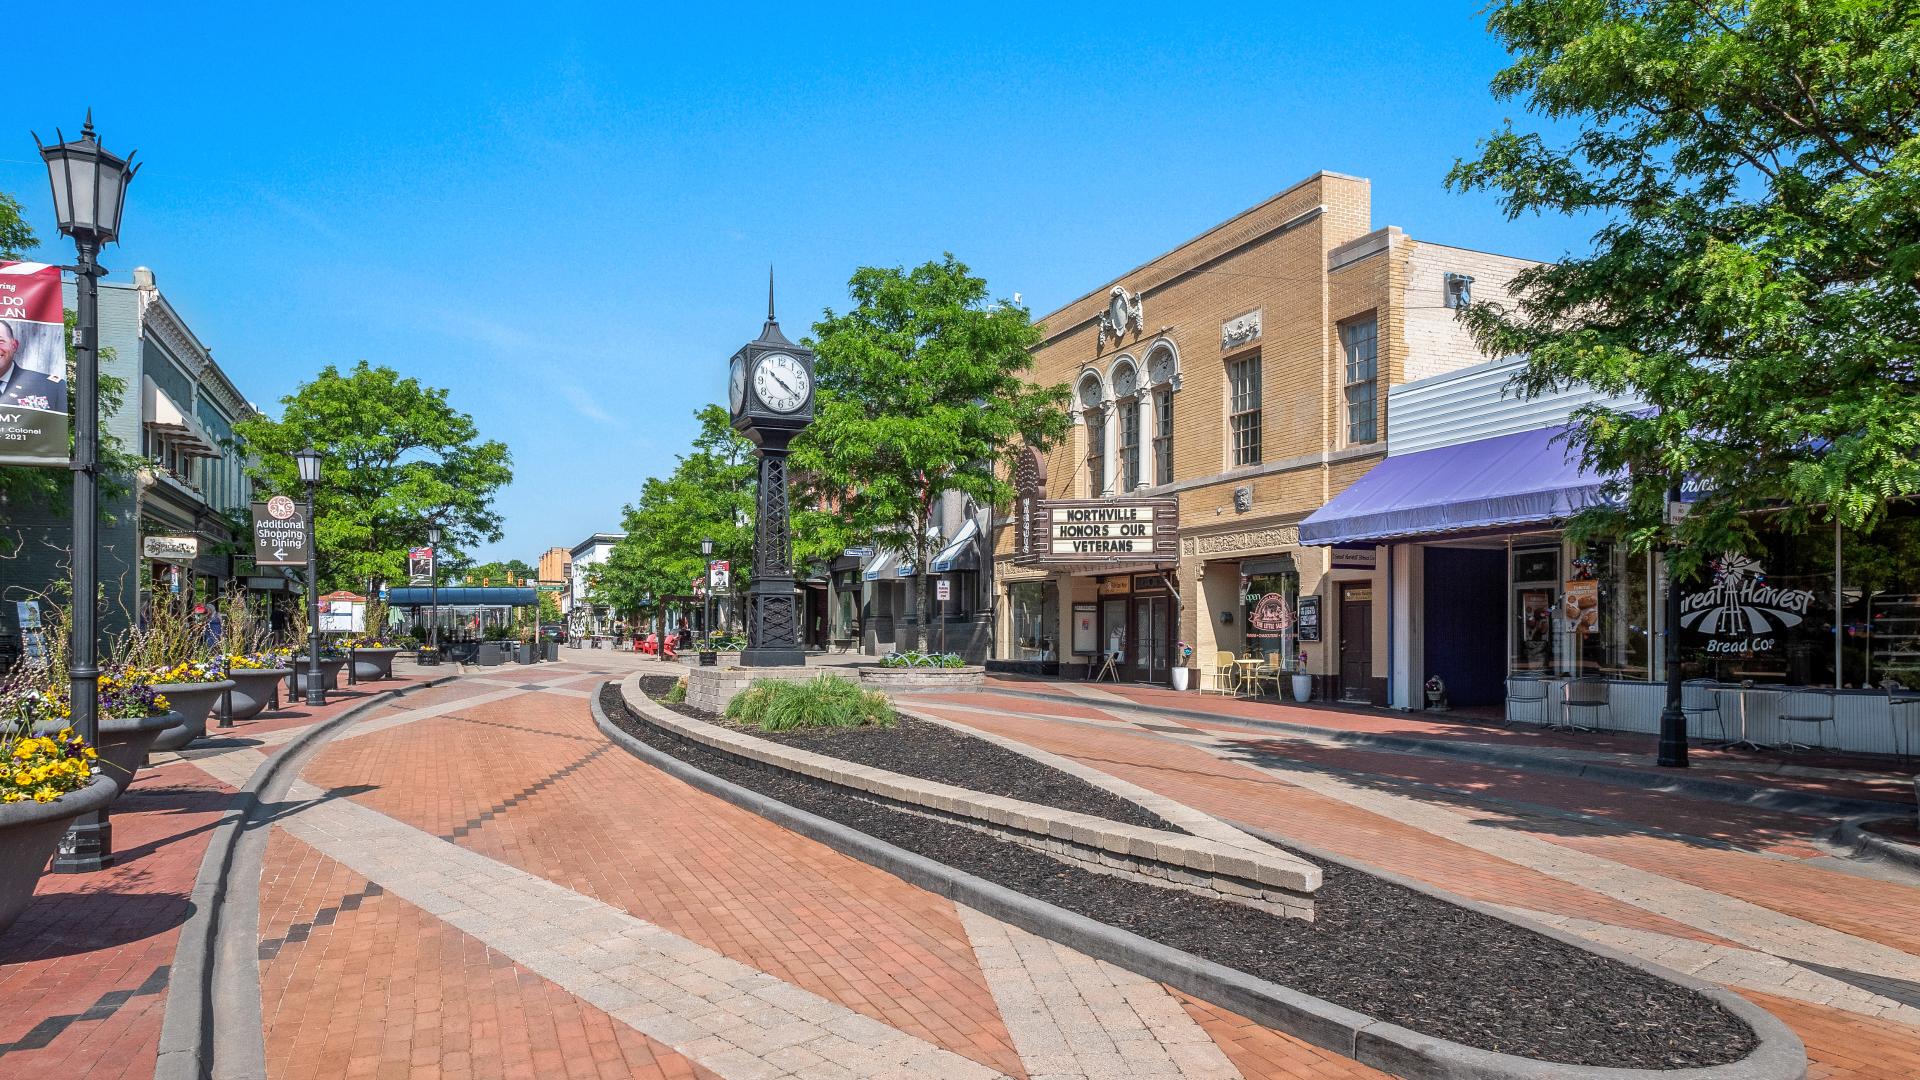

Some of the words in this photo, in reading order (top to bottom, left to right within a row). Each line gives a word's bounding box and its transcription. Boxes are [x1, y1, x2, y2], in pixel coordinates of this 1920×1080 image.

[0, 296, 24, 306] DO
[0, 308, 26, 319] AN
[778, 358, 786, 367] 12
[796, 370, 803, 379] 2
[758, 376, 764, 385] 9
[799, 381, 805, 390] 3
[761, 387, 767, 396] 8
[767, 396, 774, 405] 7
[778, 400, 784, 409] 6
[788, 397, 794, 407] 5
[8, 427, 42, 435] Colonel
[1067, 508, 1137, 522] NORTHVILLE
[256, 520, 305, 529] Additional
[258, 529, 303, 540] Shopping
[1060, 525, 1109, 537] HONORS
[1120, 524, 1146, 536] OUR
[260, 539, 267, 547] &
[271, 539, 302, 549] Dining
[1073, 540, 1134, 552] VETERANS
[1245, 594, 1260, 602] open
[1681, 581, 1725, 613] reat
[1740, 579, 1815, 615] Harvest
[1707, 639, 1748, 653] Bread
